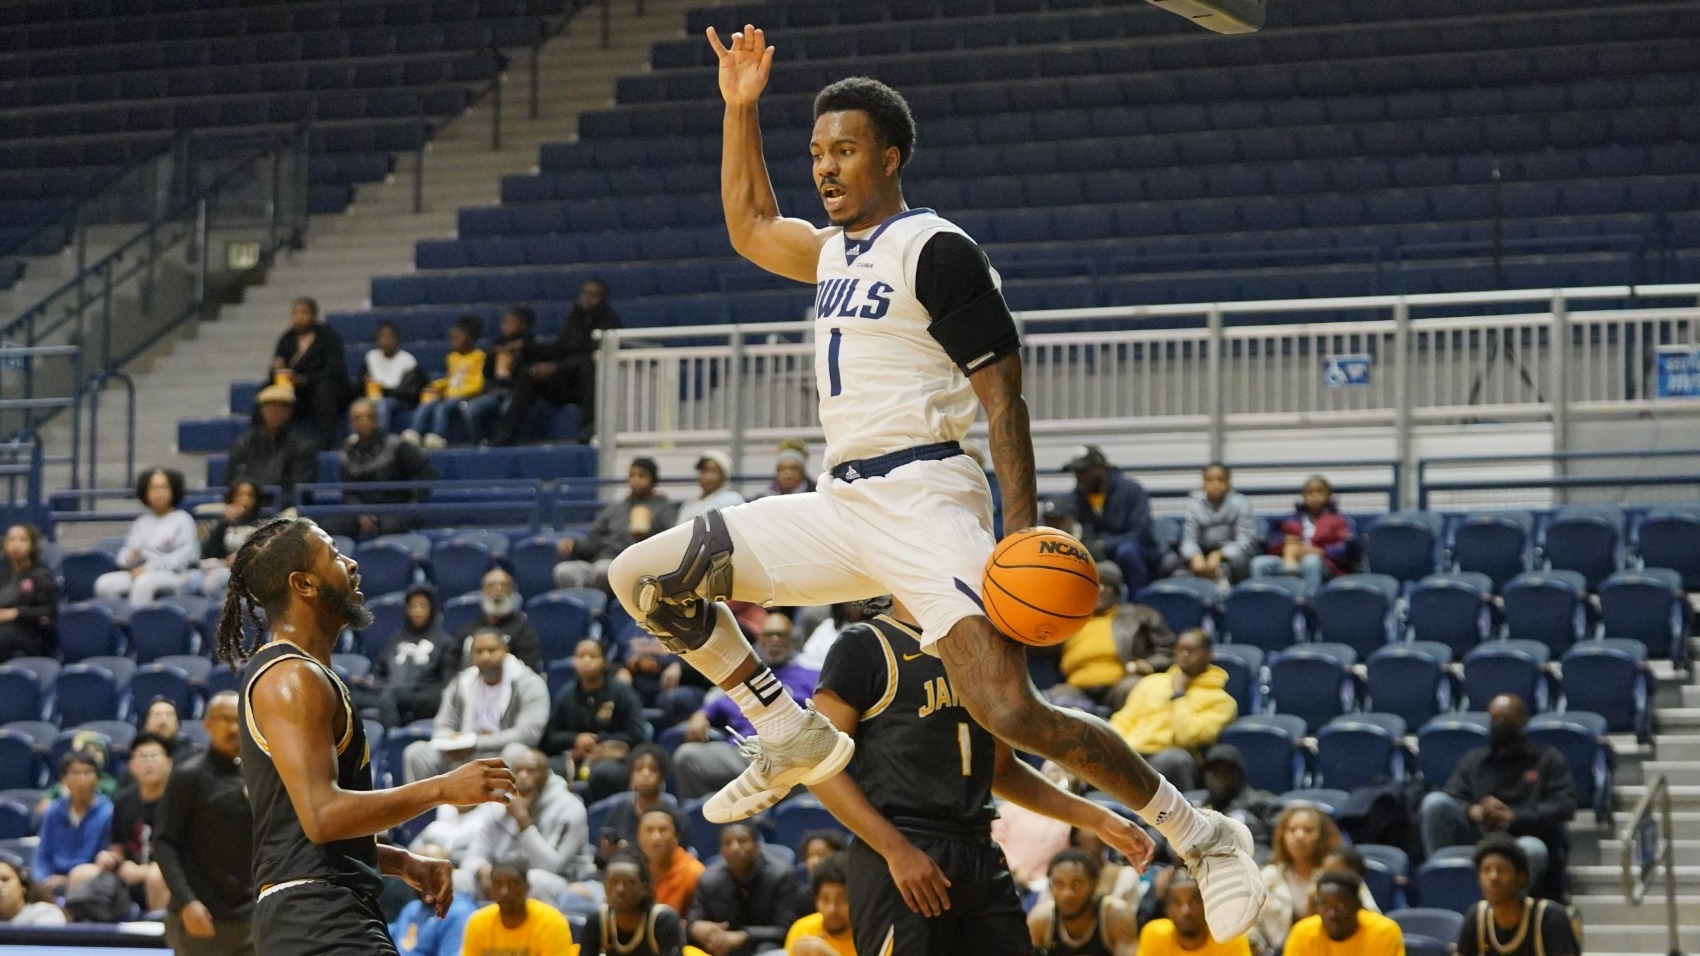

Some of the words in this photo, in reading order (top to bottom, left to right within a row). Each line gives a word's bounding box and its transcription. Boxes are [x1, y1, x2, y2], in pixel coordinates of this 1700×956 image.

[828, 327, 842, 396] 1
[1039, 540, 1090, 565] NCAA
[957, 722, 972, 776] 1
